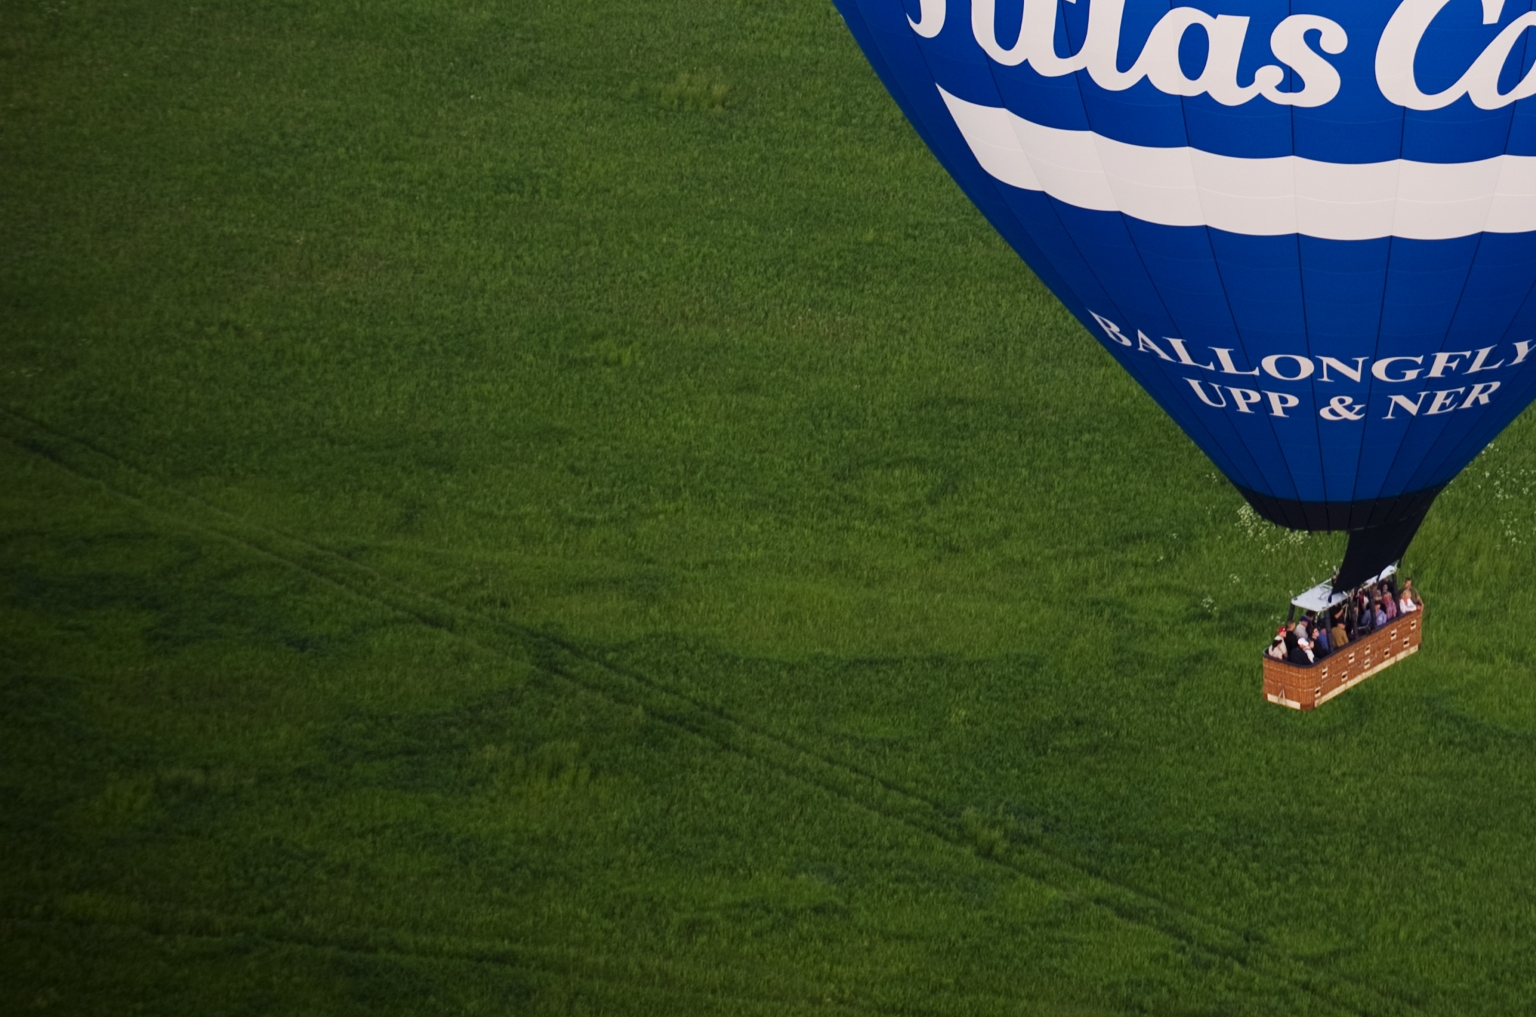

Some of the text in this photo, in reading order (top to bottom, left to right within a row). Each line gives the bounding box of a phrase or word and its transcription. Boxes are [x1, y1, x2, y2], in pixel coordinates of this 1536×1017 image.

[1182, 377, 1501, 421] UPP & NER
